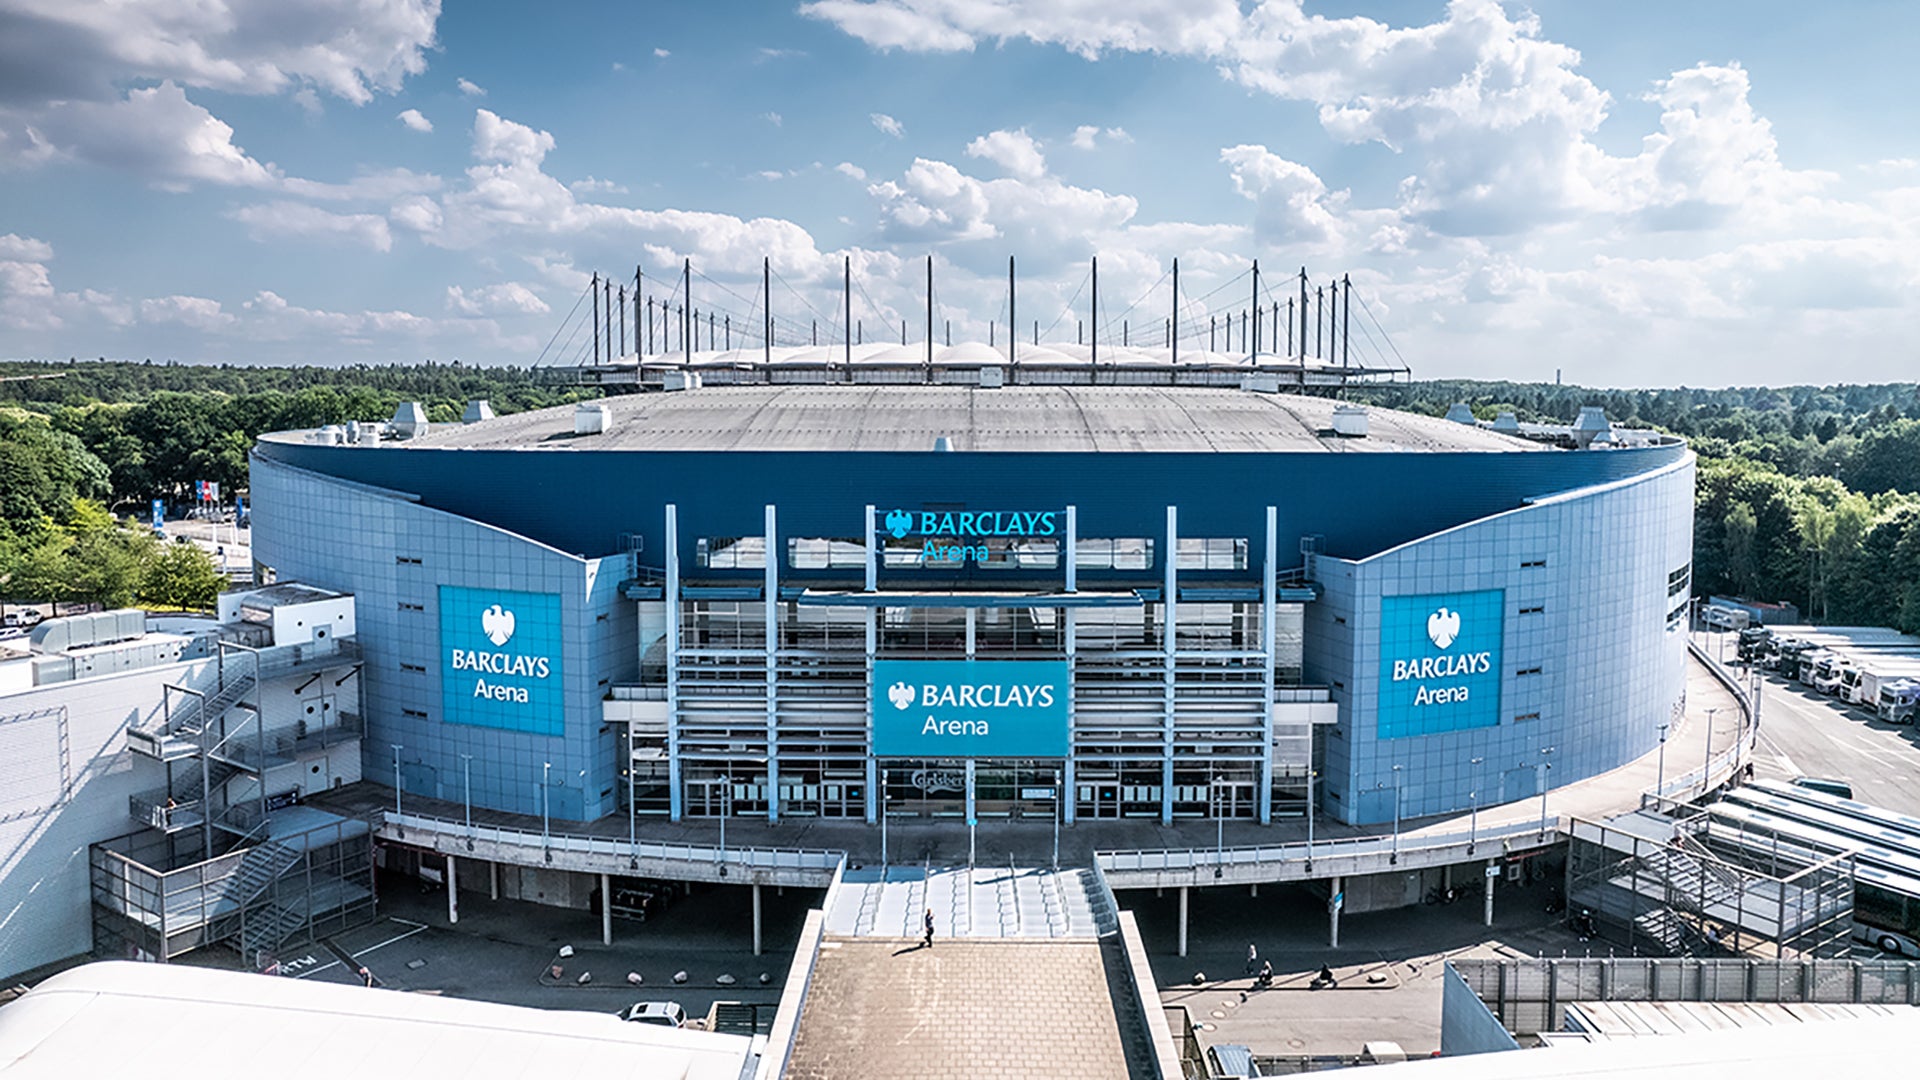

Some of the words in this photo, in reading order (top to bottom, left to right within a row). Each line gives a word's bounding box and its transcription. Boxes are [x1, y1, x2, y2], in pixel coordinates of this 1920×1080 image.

[920, 511, 1056, 536] BARCLAYS
[921, 540, 989, 562] Arena
[452, 649, 550, 678] BARCLAYS
[1393, 652, 1491, 681] BARCLAYS
[474, 678, 528, 703] Arena
[922, 684, 1055, 708] BARCLAYS
[1413, 685, 1469, 706] Arena
[921, 715, 989, 736] Arena
[911, 769, 976, 793] Carlsber
